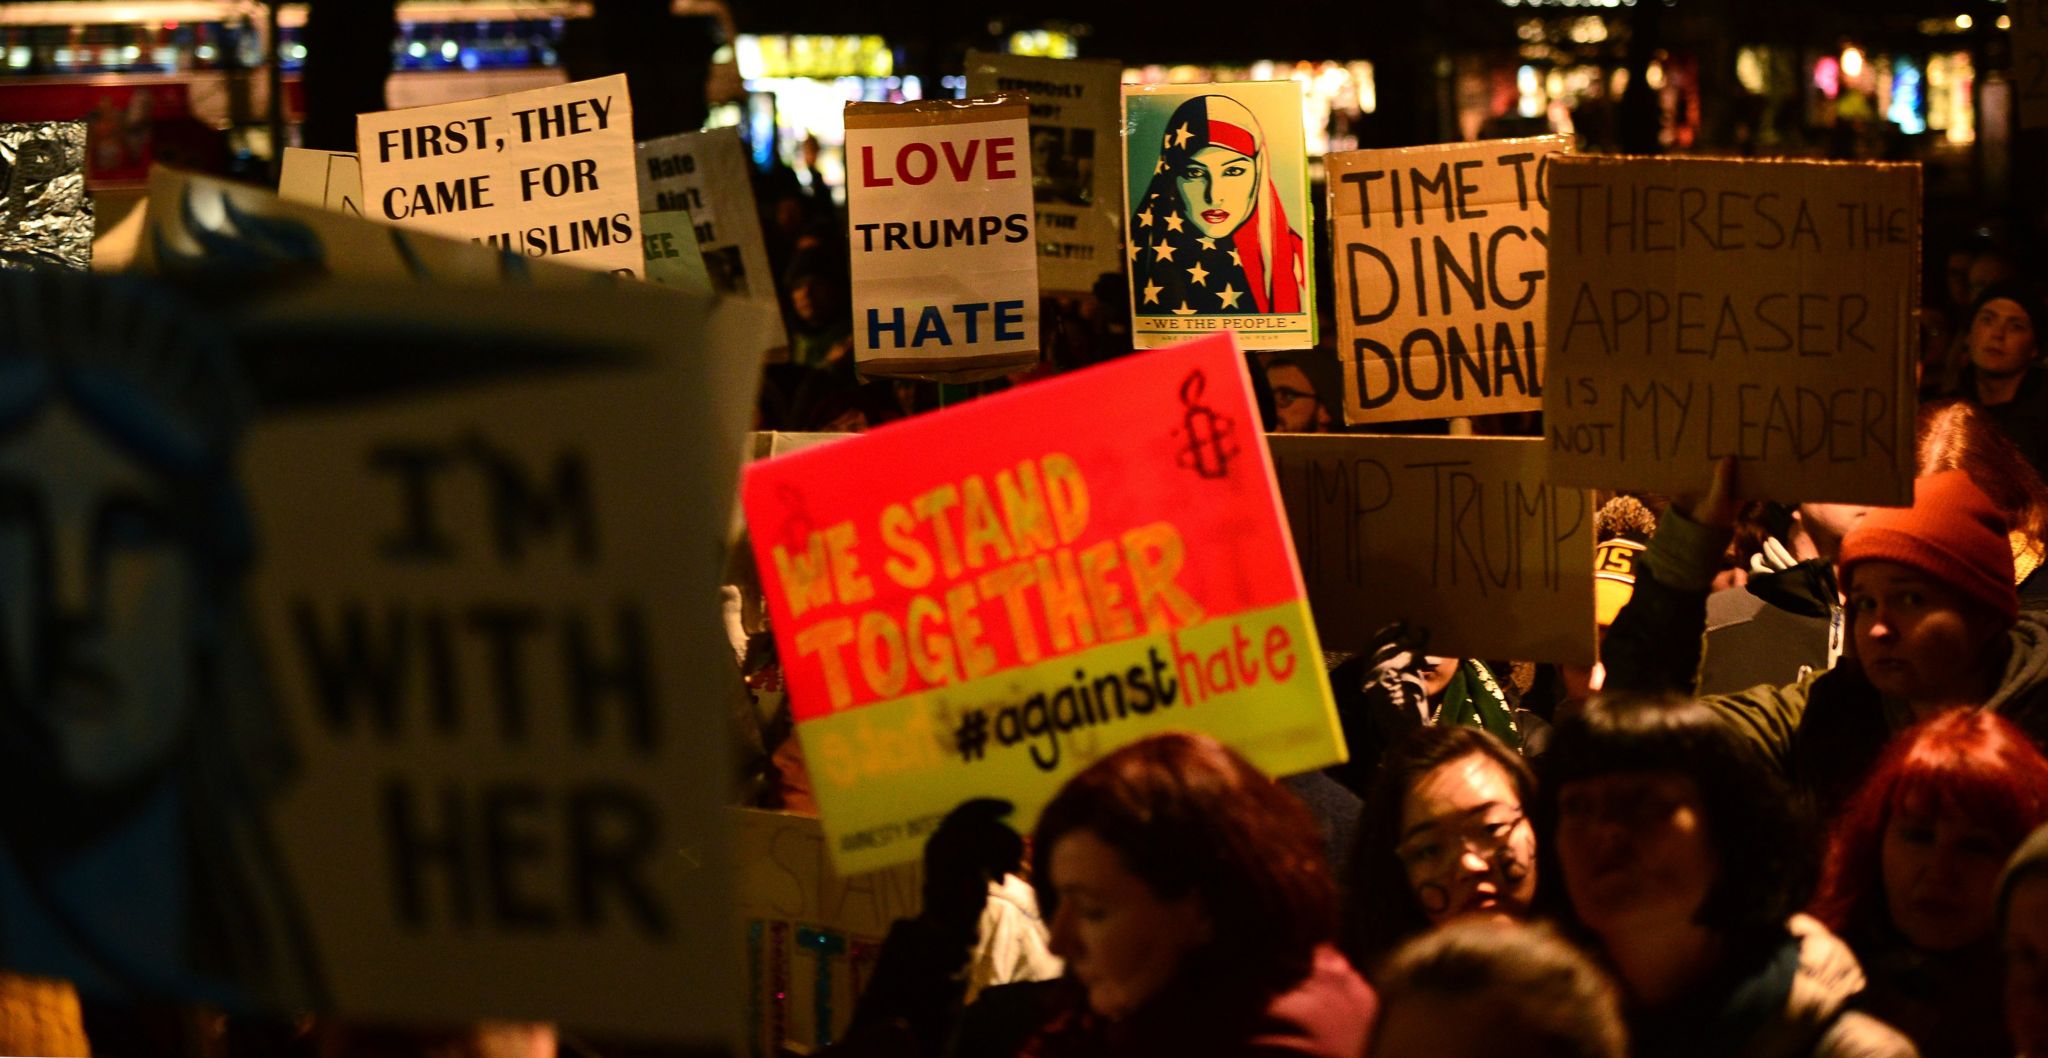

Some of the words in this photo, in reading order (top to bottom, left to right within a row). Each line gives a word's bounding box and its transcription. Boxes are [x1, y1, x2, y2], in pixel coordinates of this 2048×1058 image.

[378, 116, 504, 163] FIRST,
[512, 95, 612, 143] THEY
[861, 137, 1016, 188] LOVE
[382, 175, 494, 220] CAME
[520, 159, 600, 202] FOR
[647, 154, 696, 181] Hate
[1341, 160, 1488, 229] TIME
[855, 213, 1029, 252] TRUMPS
[1554, 182, 1823, 256] THERESA
[1837, 201, 1912, 253] THE
[867, 300, 1025, 350] HATE
[1152, 318, 1180, 330] WE
[1184, 318, 1217, 330] THE
[1223, 317, 1288, 329] PEOPLE
[1562, 281, 1876, 360] APPEASER
[1353, 321, 1543, 410] DONAL
[1564, 377, 1599, 408] IS
[1553, 423, 1615, 456] NOT
[1618, 380, 1694, 462] MY
[1706, 382, 1900, 468] LEADER
[367, 430, 598, 566] I'M
[1404, 461, 1585, 597] TRUMP
[774, 520, 874, 619] WE
[879, 452, 1090, 590] STAND
[795, 521, 1204, 713] TOGETHER
[293, 597, 660, 757] WITH
[380, 775, 675, 940] HER
